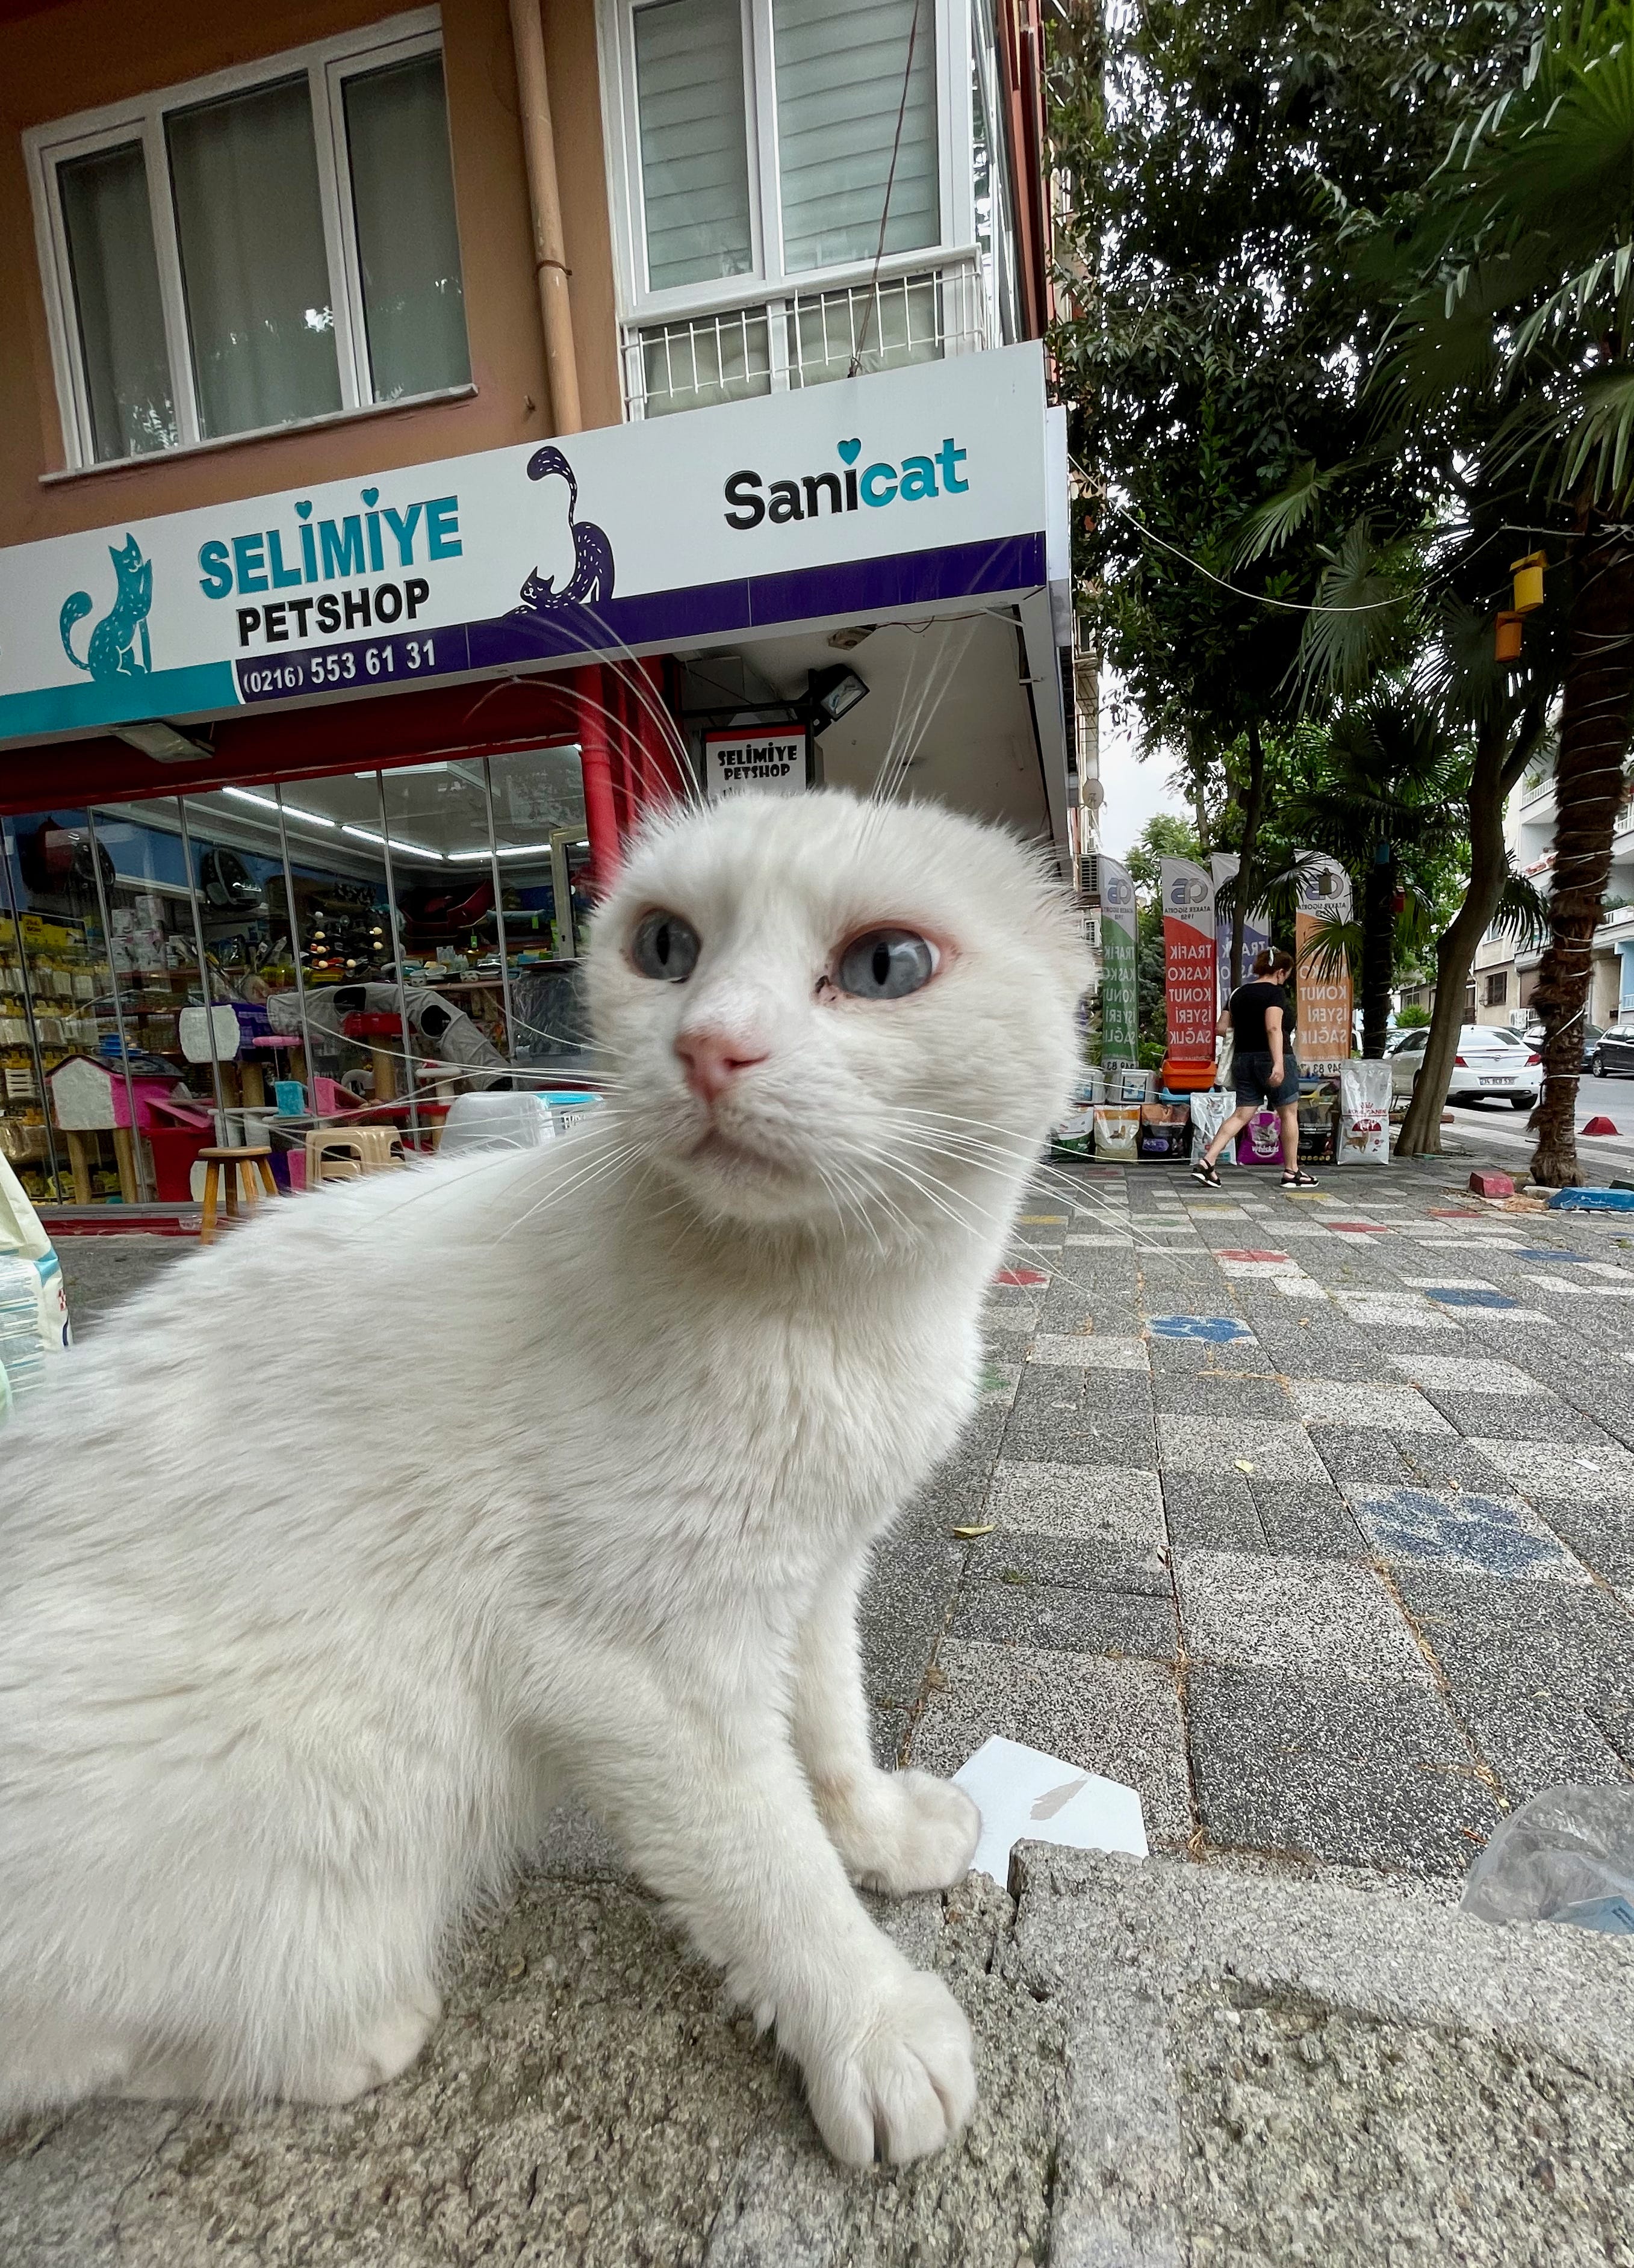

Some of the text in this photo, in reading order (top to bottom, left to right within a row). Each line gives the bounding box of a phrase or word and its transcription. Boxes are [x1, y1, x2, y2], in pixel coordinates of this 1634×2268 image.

[724, 438, 969, 530] Sanicat
[199, 487, 462, 599] SELİMİYE
[238, 578, 429, 646] PETSHOP
[243, 639, 435, 693] (0216) 553 61 31
[717, 742, 797, 766] SELİMİYE
[724, 763, 790, 780] PETSHOP
